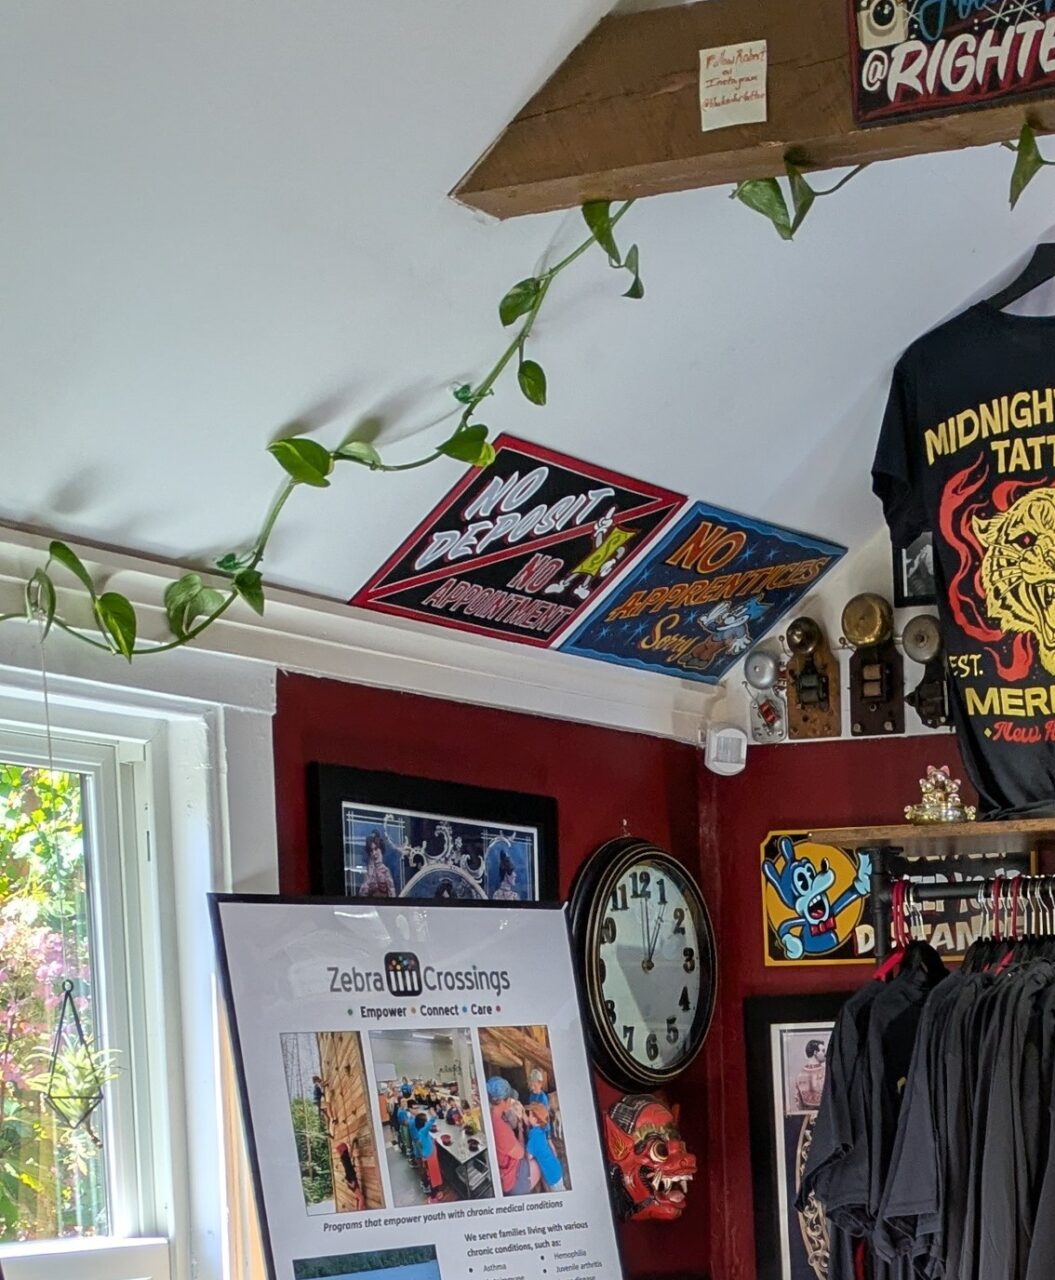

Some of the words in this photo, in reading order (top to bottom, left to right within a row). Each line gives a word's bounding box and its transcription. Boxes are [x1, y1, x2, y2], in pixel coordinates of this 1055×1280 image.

[462, 465, 550, 522] NO
[413, 488, 616, 570] DEPOSIT
[665, 522, 747, 575] NO
[507, 553, 565, 593] NO
[605, 556, 833, 623] APPRENTICES
[421, 577, 575, 634] APPOINTMENT
[641, 612, 701, 663] Sorry
[992, 721, 1042, 743] New
[629, 871, 651, 899] 12
[656, 878, 667, 905] 1
[673, 908, 685, 935] 2
[683, 947, 695, 973] 3
[327, 965, 385, 994] Zebra
[423, 964, 511, 1001] Crossings
[360, 1004, 407, 1020] Empower
[419, 1003, 460, 1017] Connect
[470, 1003, 493, 1016] Care
[679, 986, 690, 1011] 4
[623, 1025, 634, 1052] 7
[666, 1015, 679, 1043] 5
[646, 1034, 658, 1061] 6
[323, 1217, 362, 1232] Programs
[364, 1217, 382, 1229] that
[383, 1215, 422, 1229] empower
[423, 1211, 446, 1225] youth
[448, 1208, 465, 1219] with
[466, 1205, 494, 1218] chronic
[496, 1202, 525, 1216] medical
[526, 1199, 564, 1212] conditions
[464, 1232, 477, 1243] We
[478, 1230, 498, 1240] serve
[498, 1225, 526, 1239] families
[527, 1223, 546, 1236] living
[547, 1222, 563, 1233] with
[564, 1220, 589, 1231] various
[467, 1246, 494, 1258] chronic
[534, 1240, 550, 1250] such
